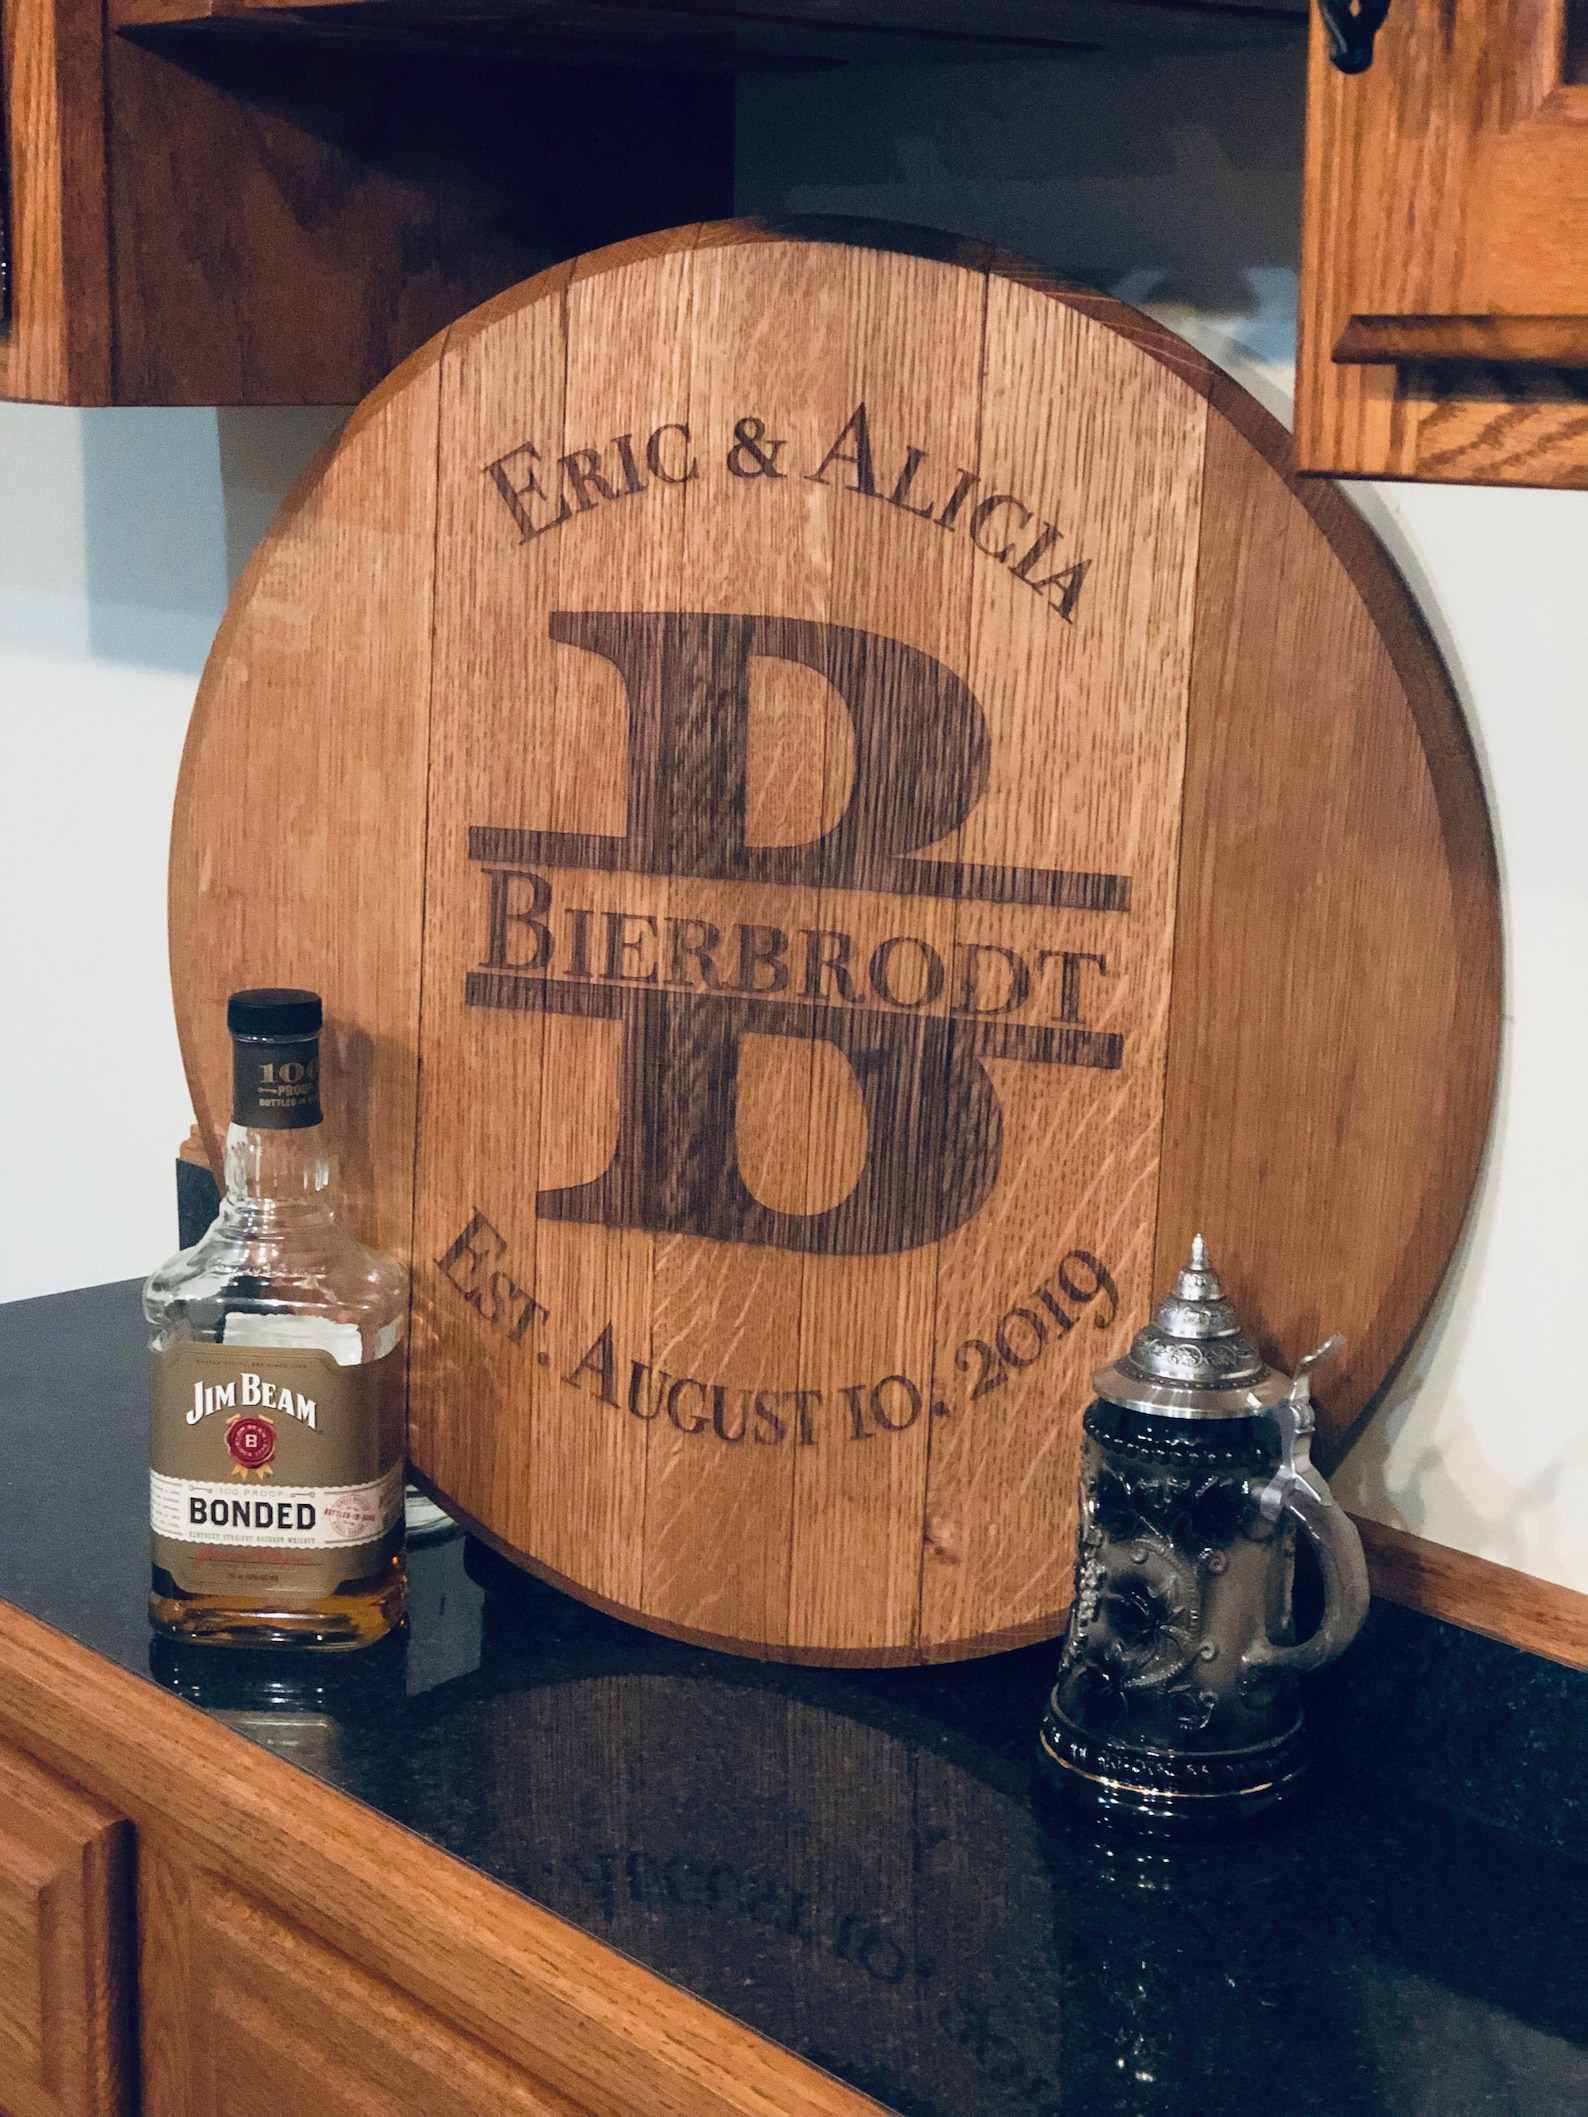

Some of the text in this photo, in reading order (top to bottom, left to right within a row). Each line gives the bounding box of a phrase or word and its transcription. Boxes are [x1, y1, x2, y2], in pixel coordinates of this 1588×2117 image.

[484, 401, 1094, 625] ERIC & ALICIA
[479, 867, 1108, 1024] BIERBRODT
[432, 1205, 550, 1366] EST.
[562, 1321, 824, 1446] AUGUST
[954, 1248, 1120, 1401] 2019
[186, 1373, 317, 1430] JIM BEAM
[245, 1434, 258, 1448] B
[189, 1497, 316, 1530] BONDED
[219, 1487, 283, 1497] 100 PROOF
